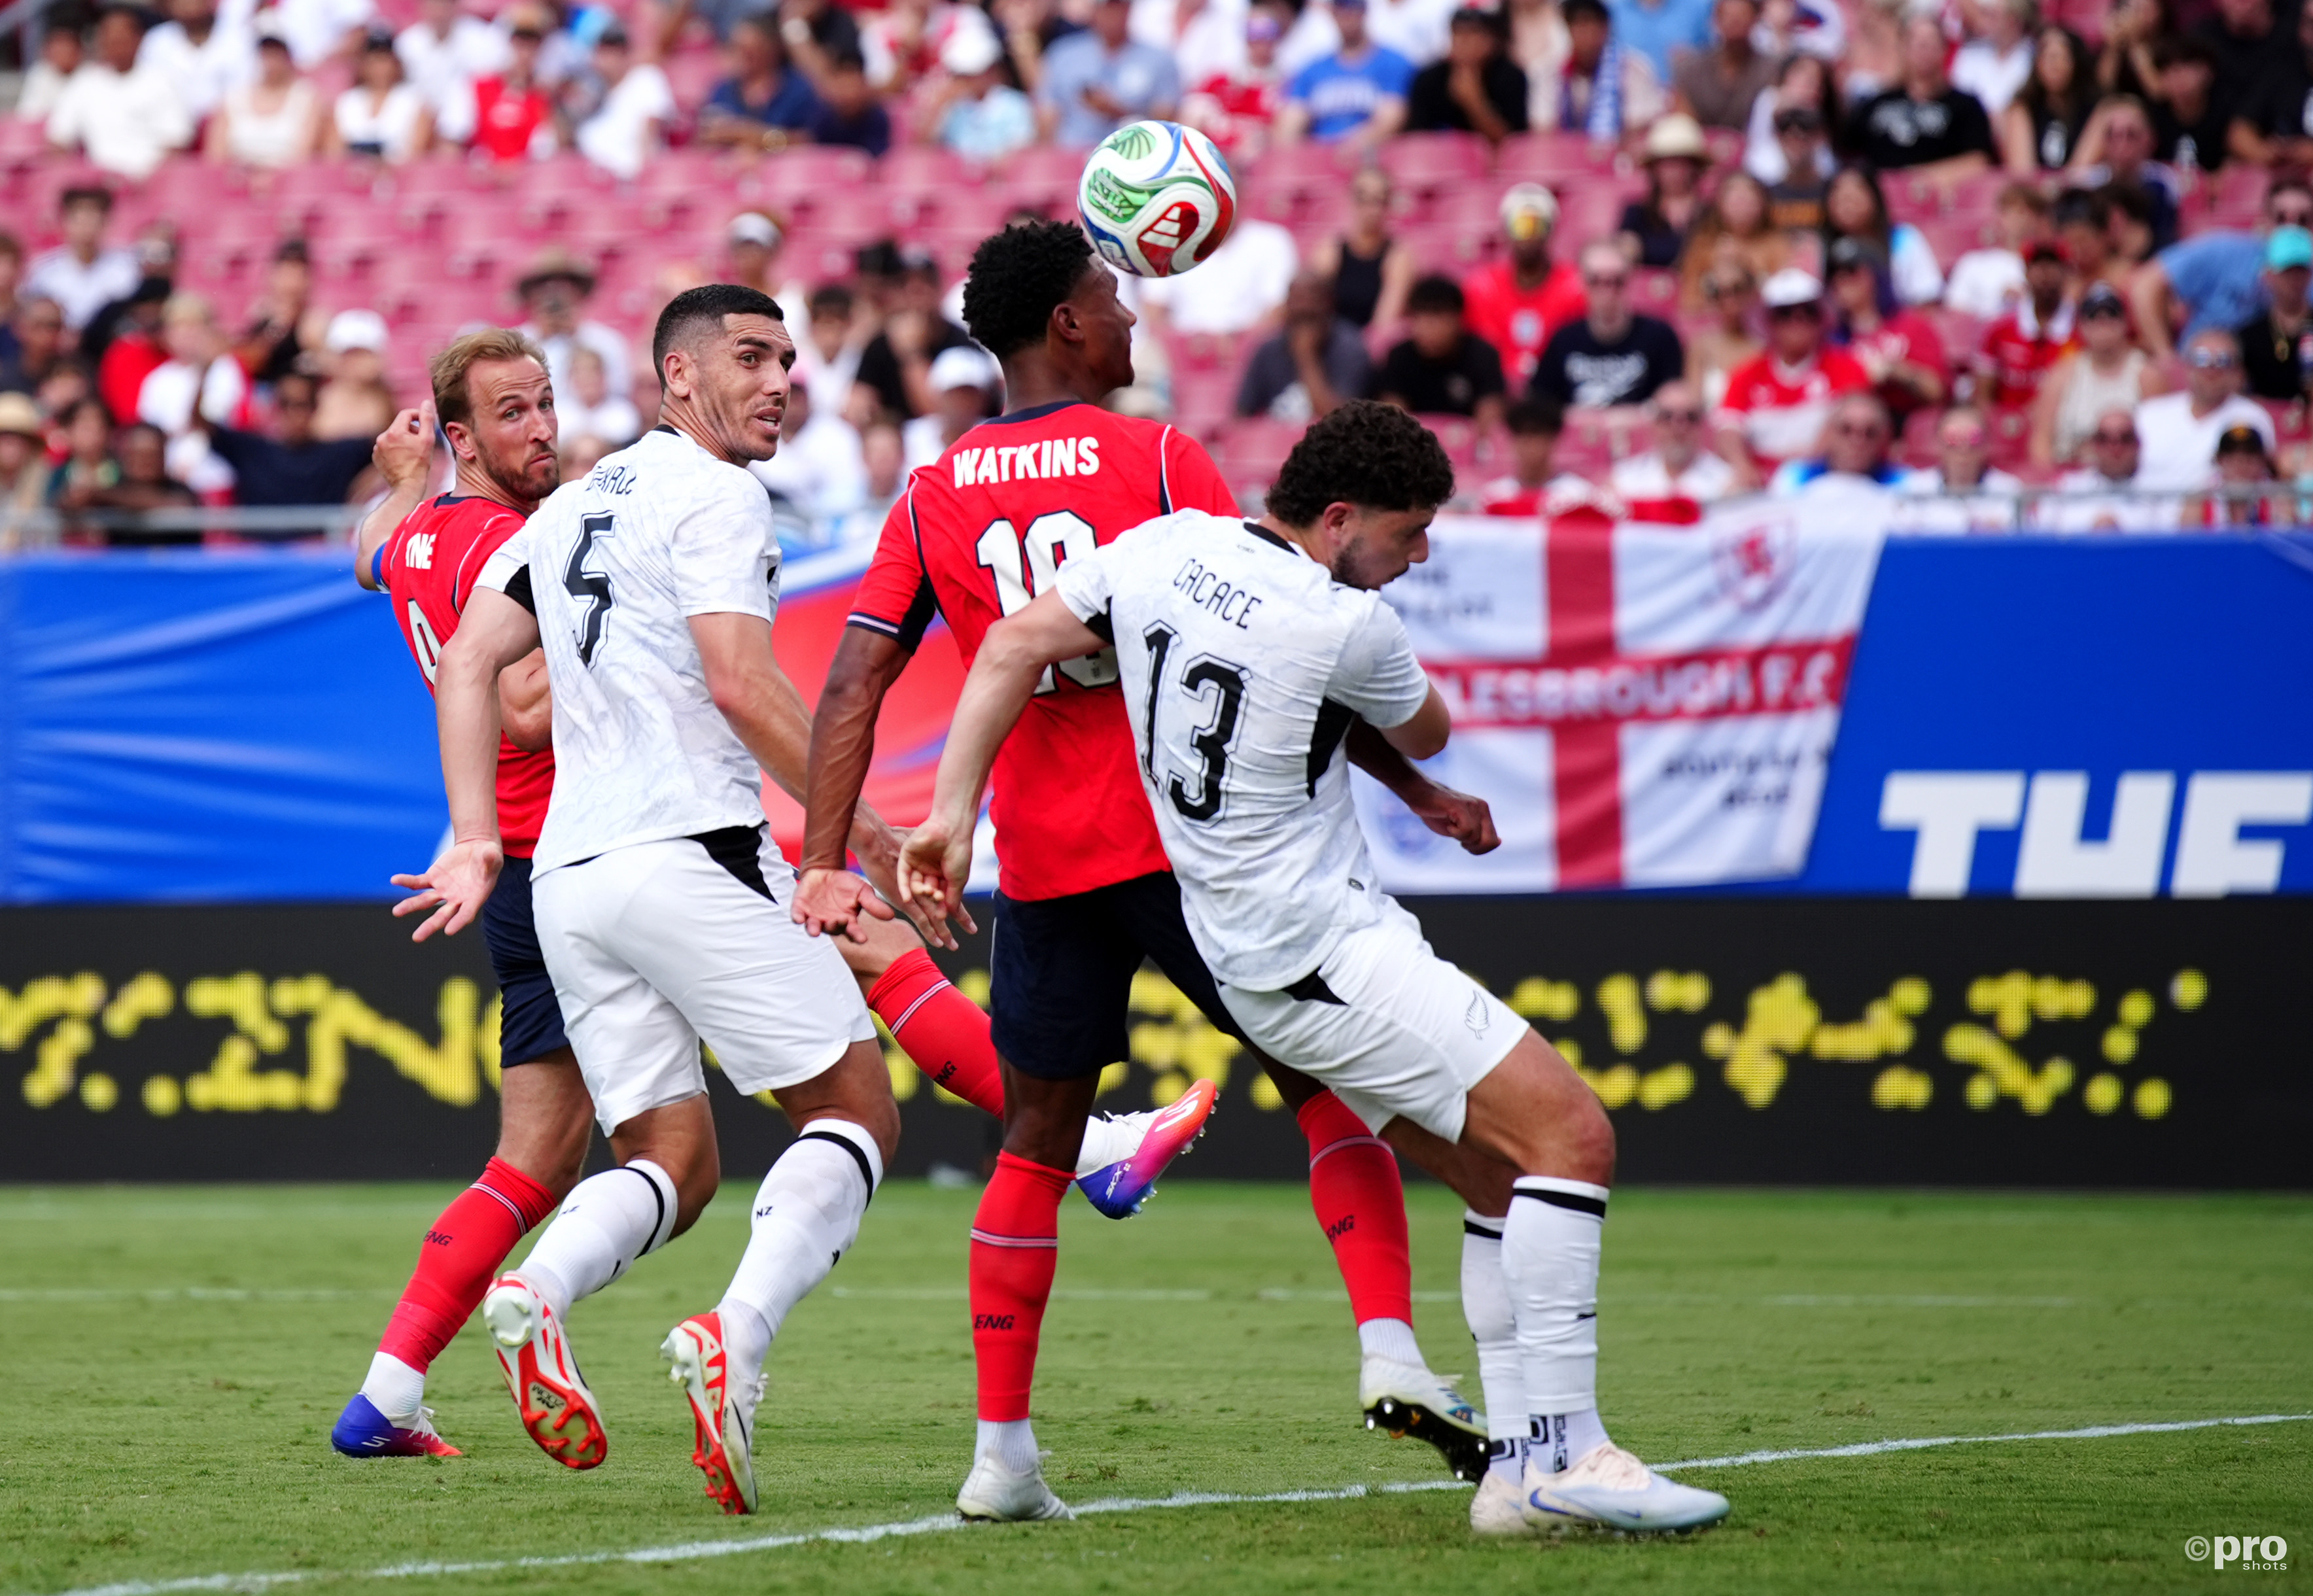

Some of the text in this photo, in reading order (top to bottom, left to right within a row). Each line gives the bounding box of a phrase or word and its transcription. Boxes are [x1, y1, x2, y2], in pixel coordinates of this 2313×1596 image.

[953, 436, 1100, 489] WATKINS
[563, 510, 617, 674] 5
[1174, 558, 1262, 630] CACACE
[1430, 657, 1754, 721] LESBROUGH
[1142, 619, 1253, 829] 13
[756, 1206, 773, 1220] NZ
[975, 1314, 1015, 1329] ENG
